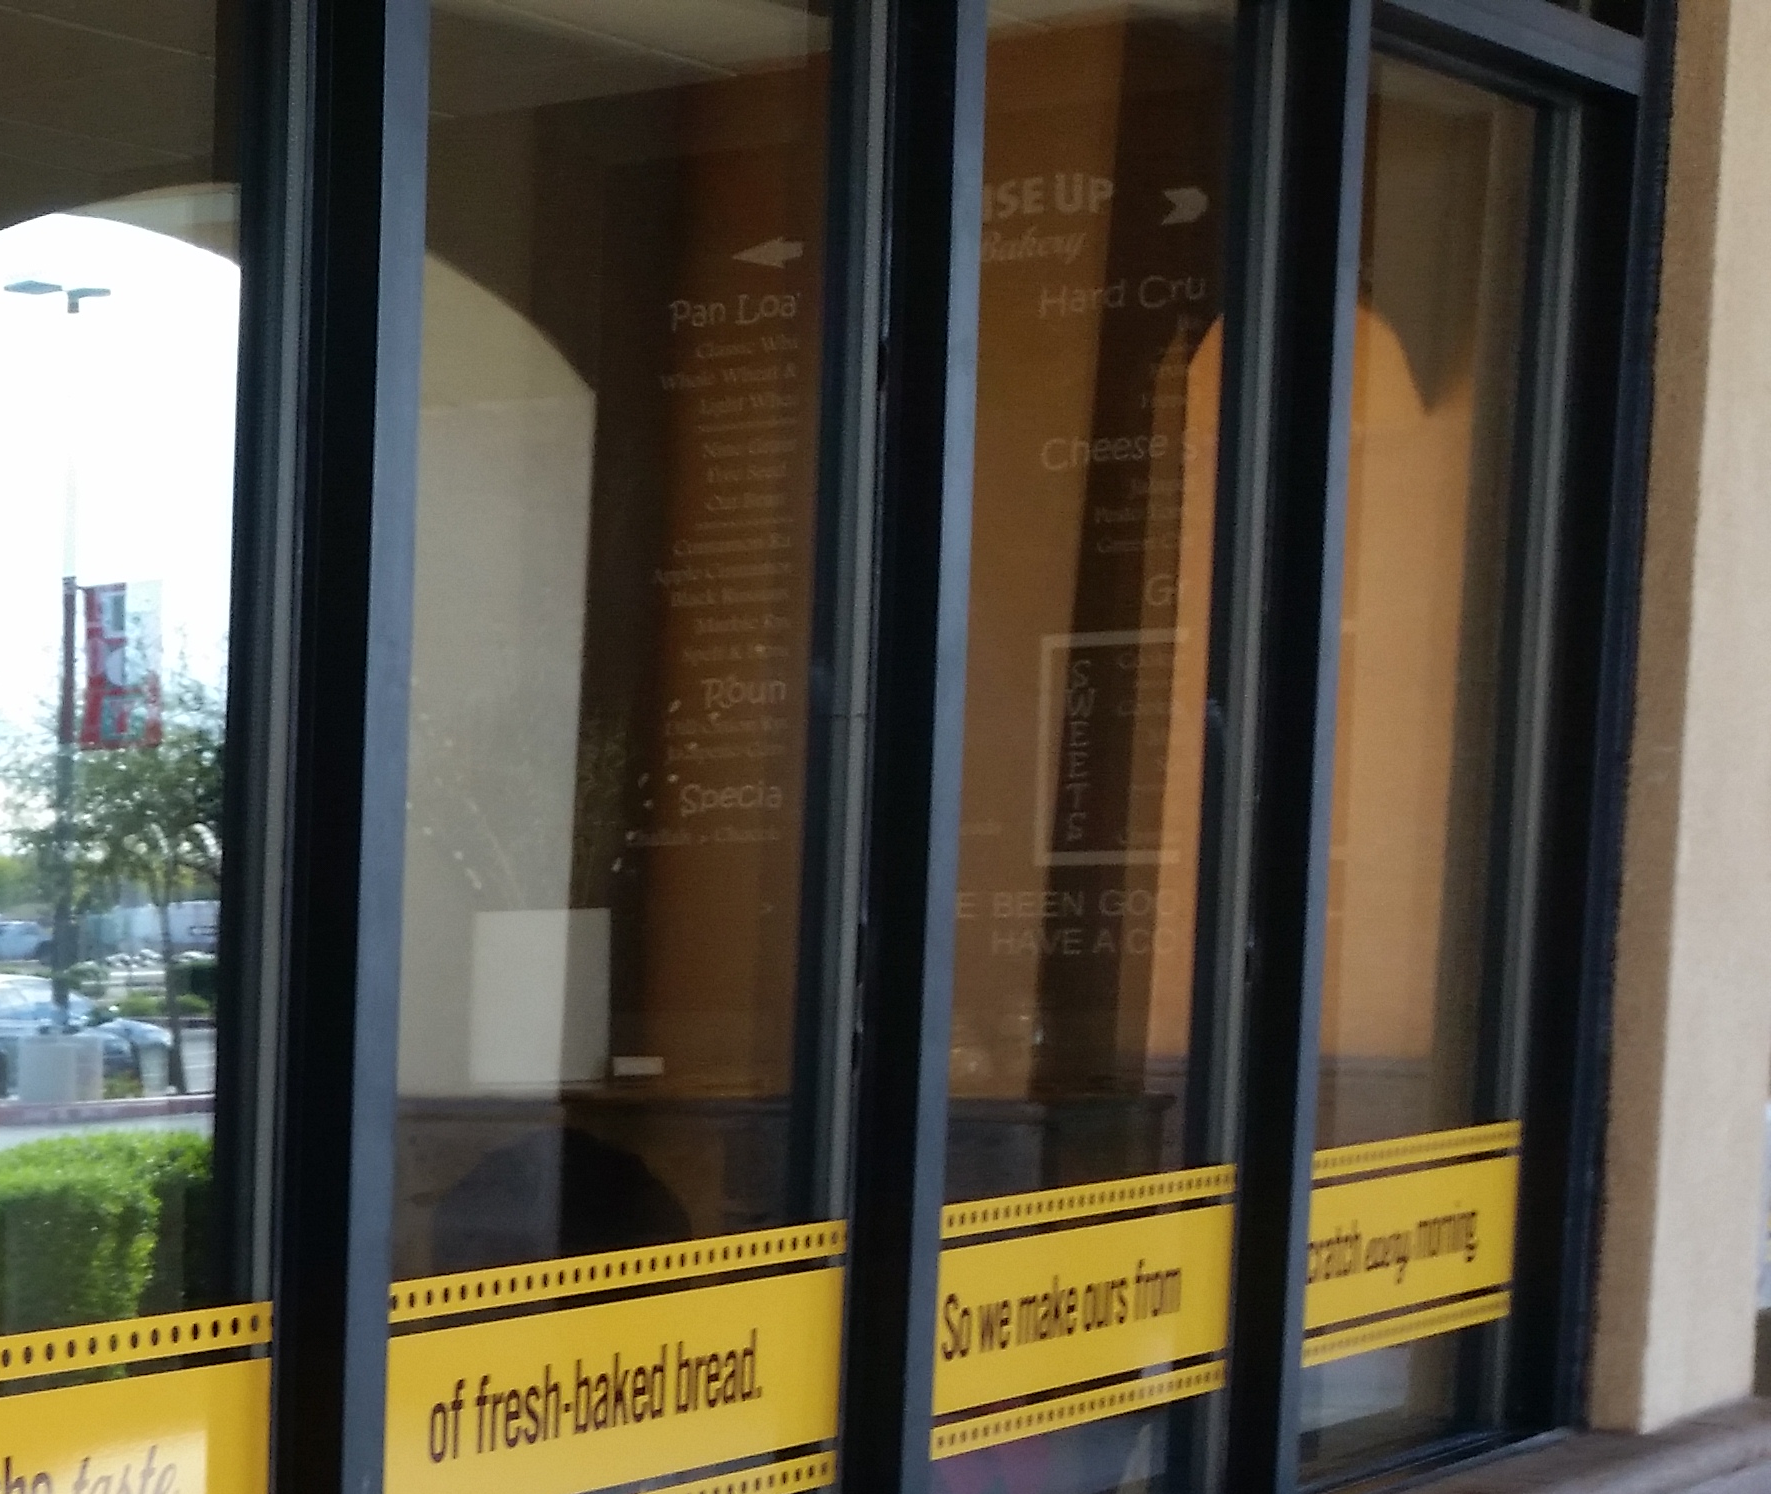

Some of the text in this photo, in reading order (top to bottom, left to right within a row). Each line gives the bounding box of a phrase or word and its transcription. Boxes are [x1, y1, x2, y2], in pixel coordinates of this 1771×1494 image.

[1055, 173, 1114, 214] UP
[670, 292, 801, 332] Pan Loa
[1038, 280, 1126, 319] Hard
[941, 1257, 1183, 1362] So we make ours from
[429, 1326, 763, 1464] of fresh-baked bread.
